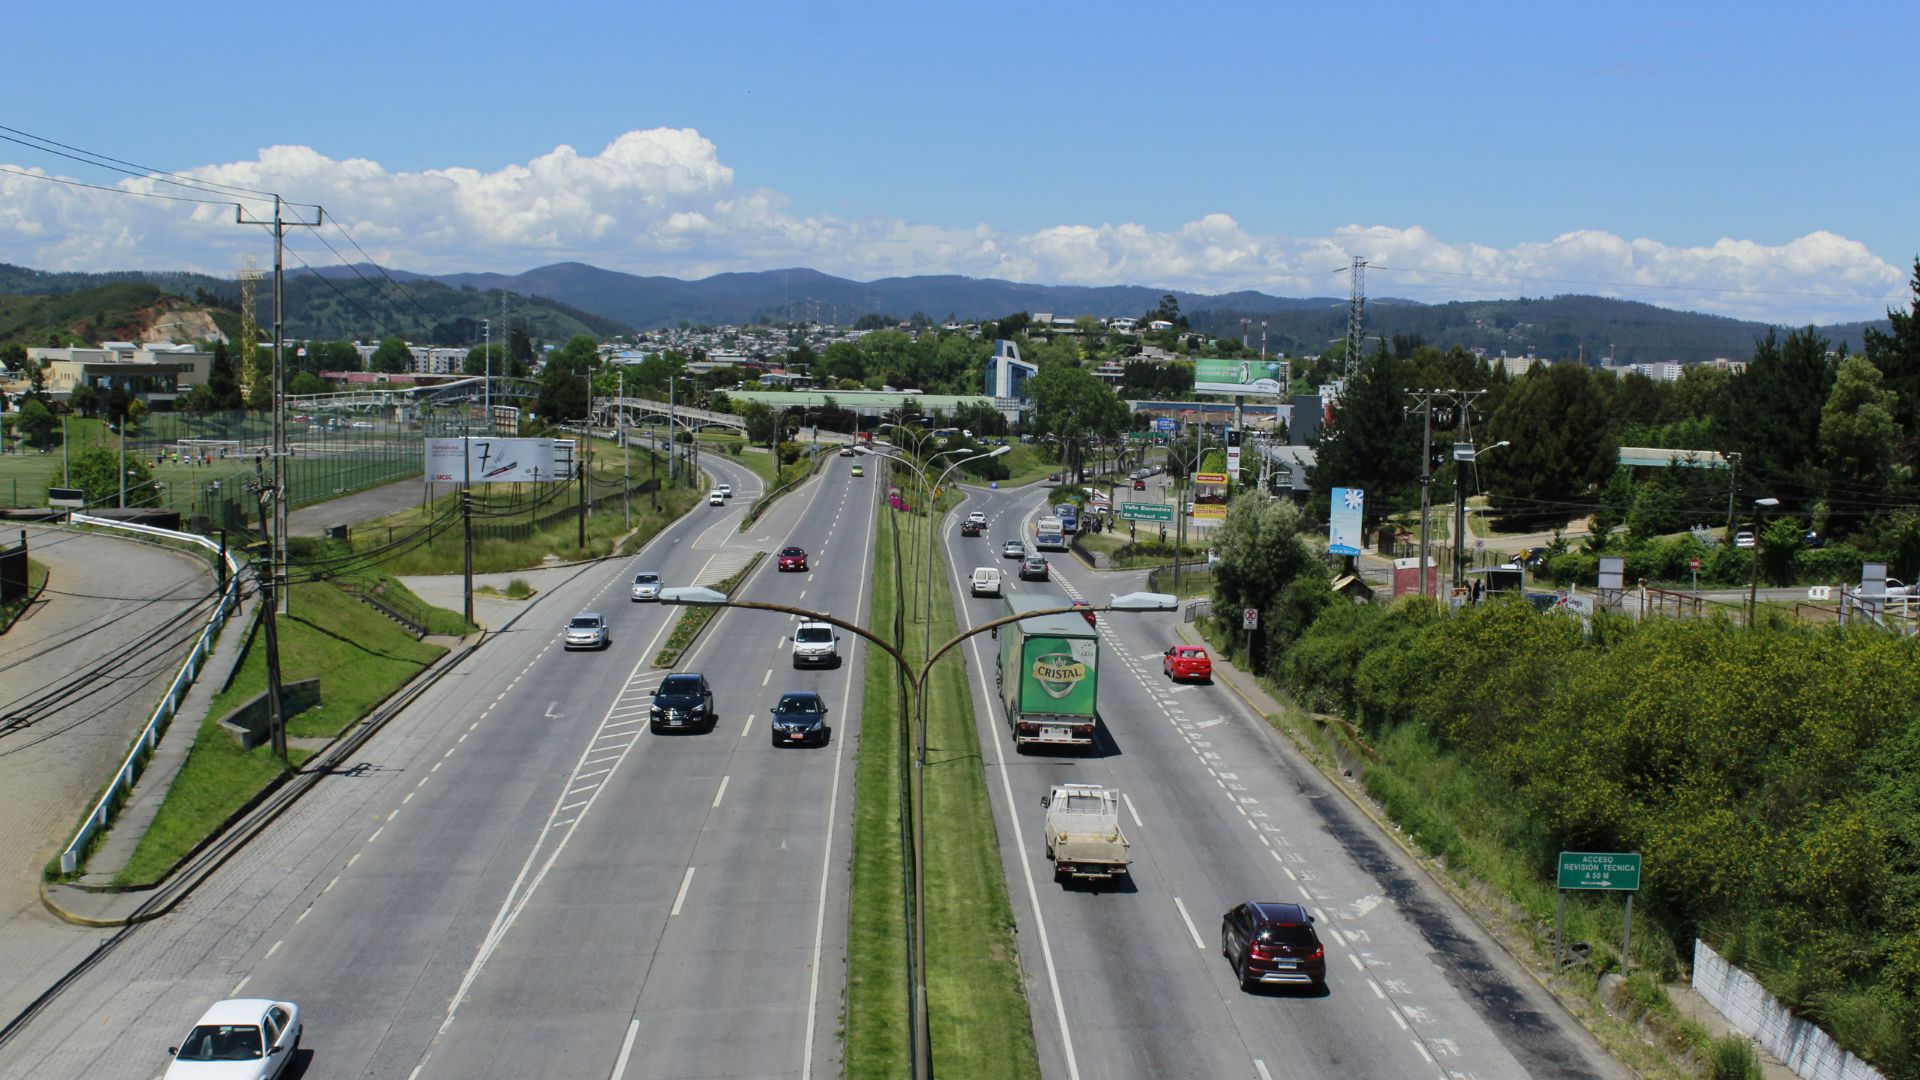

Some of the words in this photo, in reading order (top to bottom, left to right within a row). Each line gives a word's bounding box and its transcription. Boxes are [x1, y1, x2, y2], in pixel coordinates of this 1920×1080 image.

[1037, 666, 1083, 679] CRISTAL
[1582, 855, 1614, 864] ACCESO
[1563, 863, 1599, 871] REVISIÓN
[1592, 872, 1601, 880] 50
